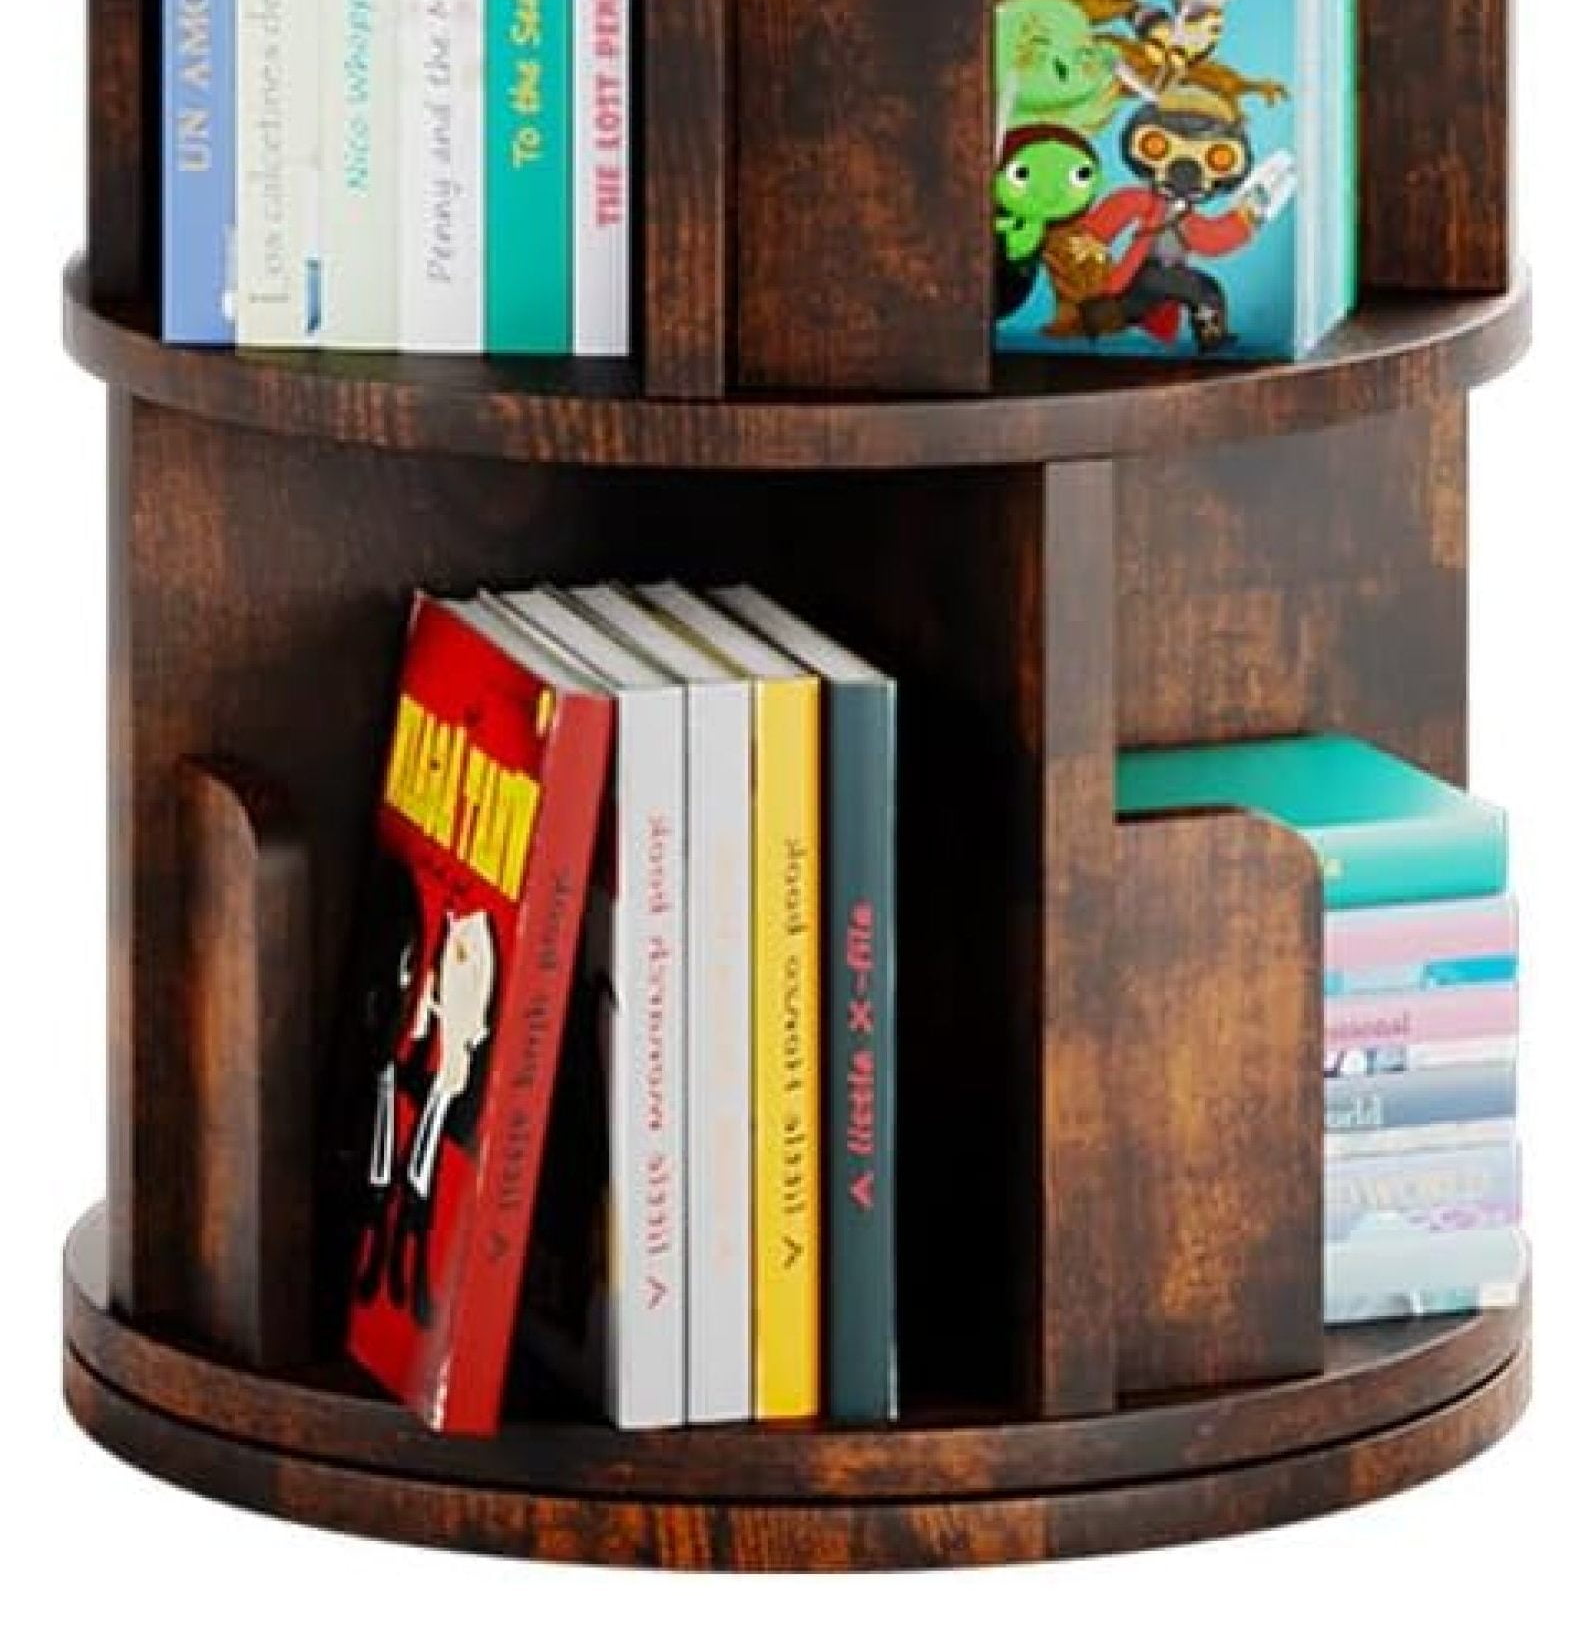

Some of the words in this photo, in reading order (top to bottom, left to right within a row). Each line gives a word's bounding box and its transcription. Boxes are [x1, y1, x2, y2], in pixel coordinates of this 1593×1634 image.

[424, 33, 451, 89] the
[510, 60, 542, 114] the
[176, 106, 210, 174] UN
[247, 52, 284, 224] calcetines
[424, 103, 451, 166] and
[592, 73, 622, 151] LOST
[344, 120, 371, 196] Nico
[509, 126, 543, 168] To
[592, 166, 622, 229] THE
[424, 180, 461, 284] Penny
[250, 234, 291, 307] Los
[845, 1049, 874, 1157] little
[847, 1170, 875, 1210] A
